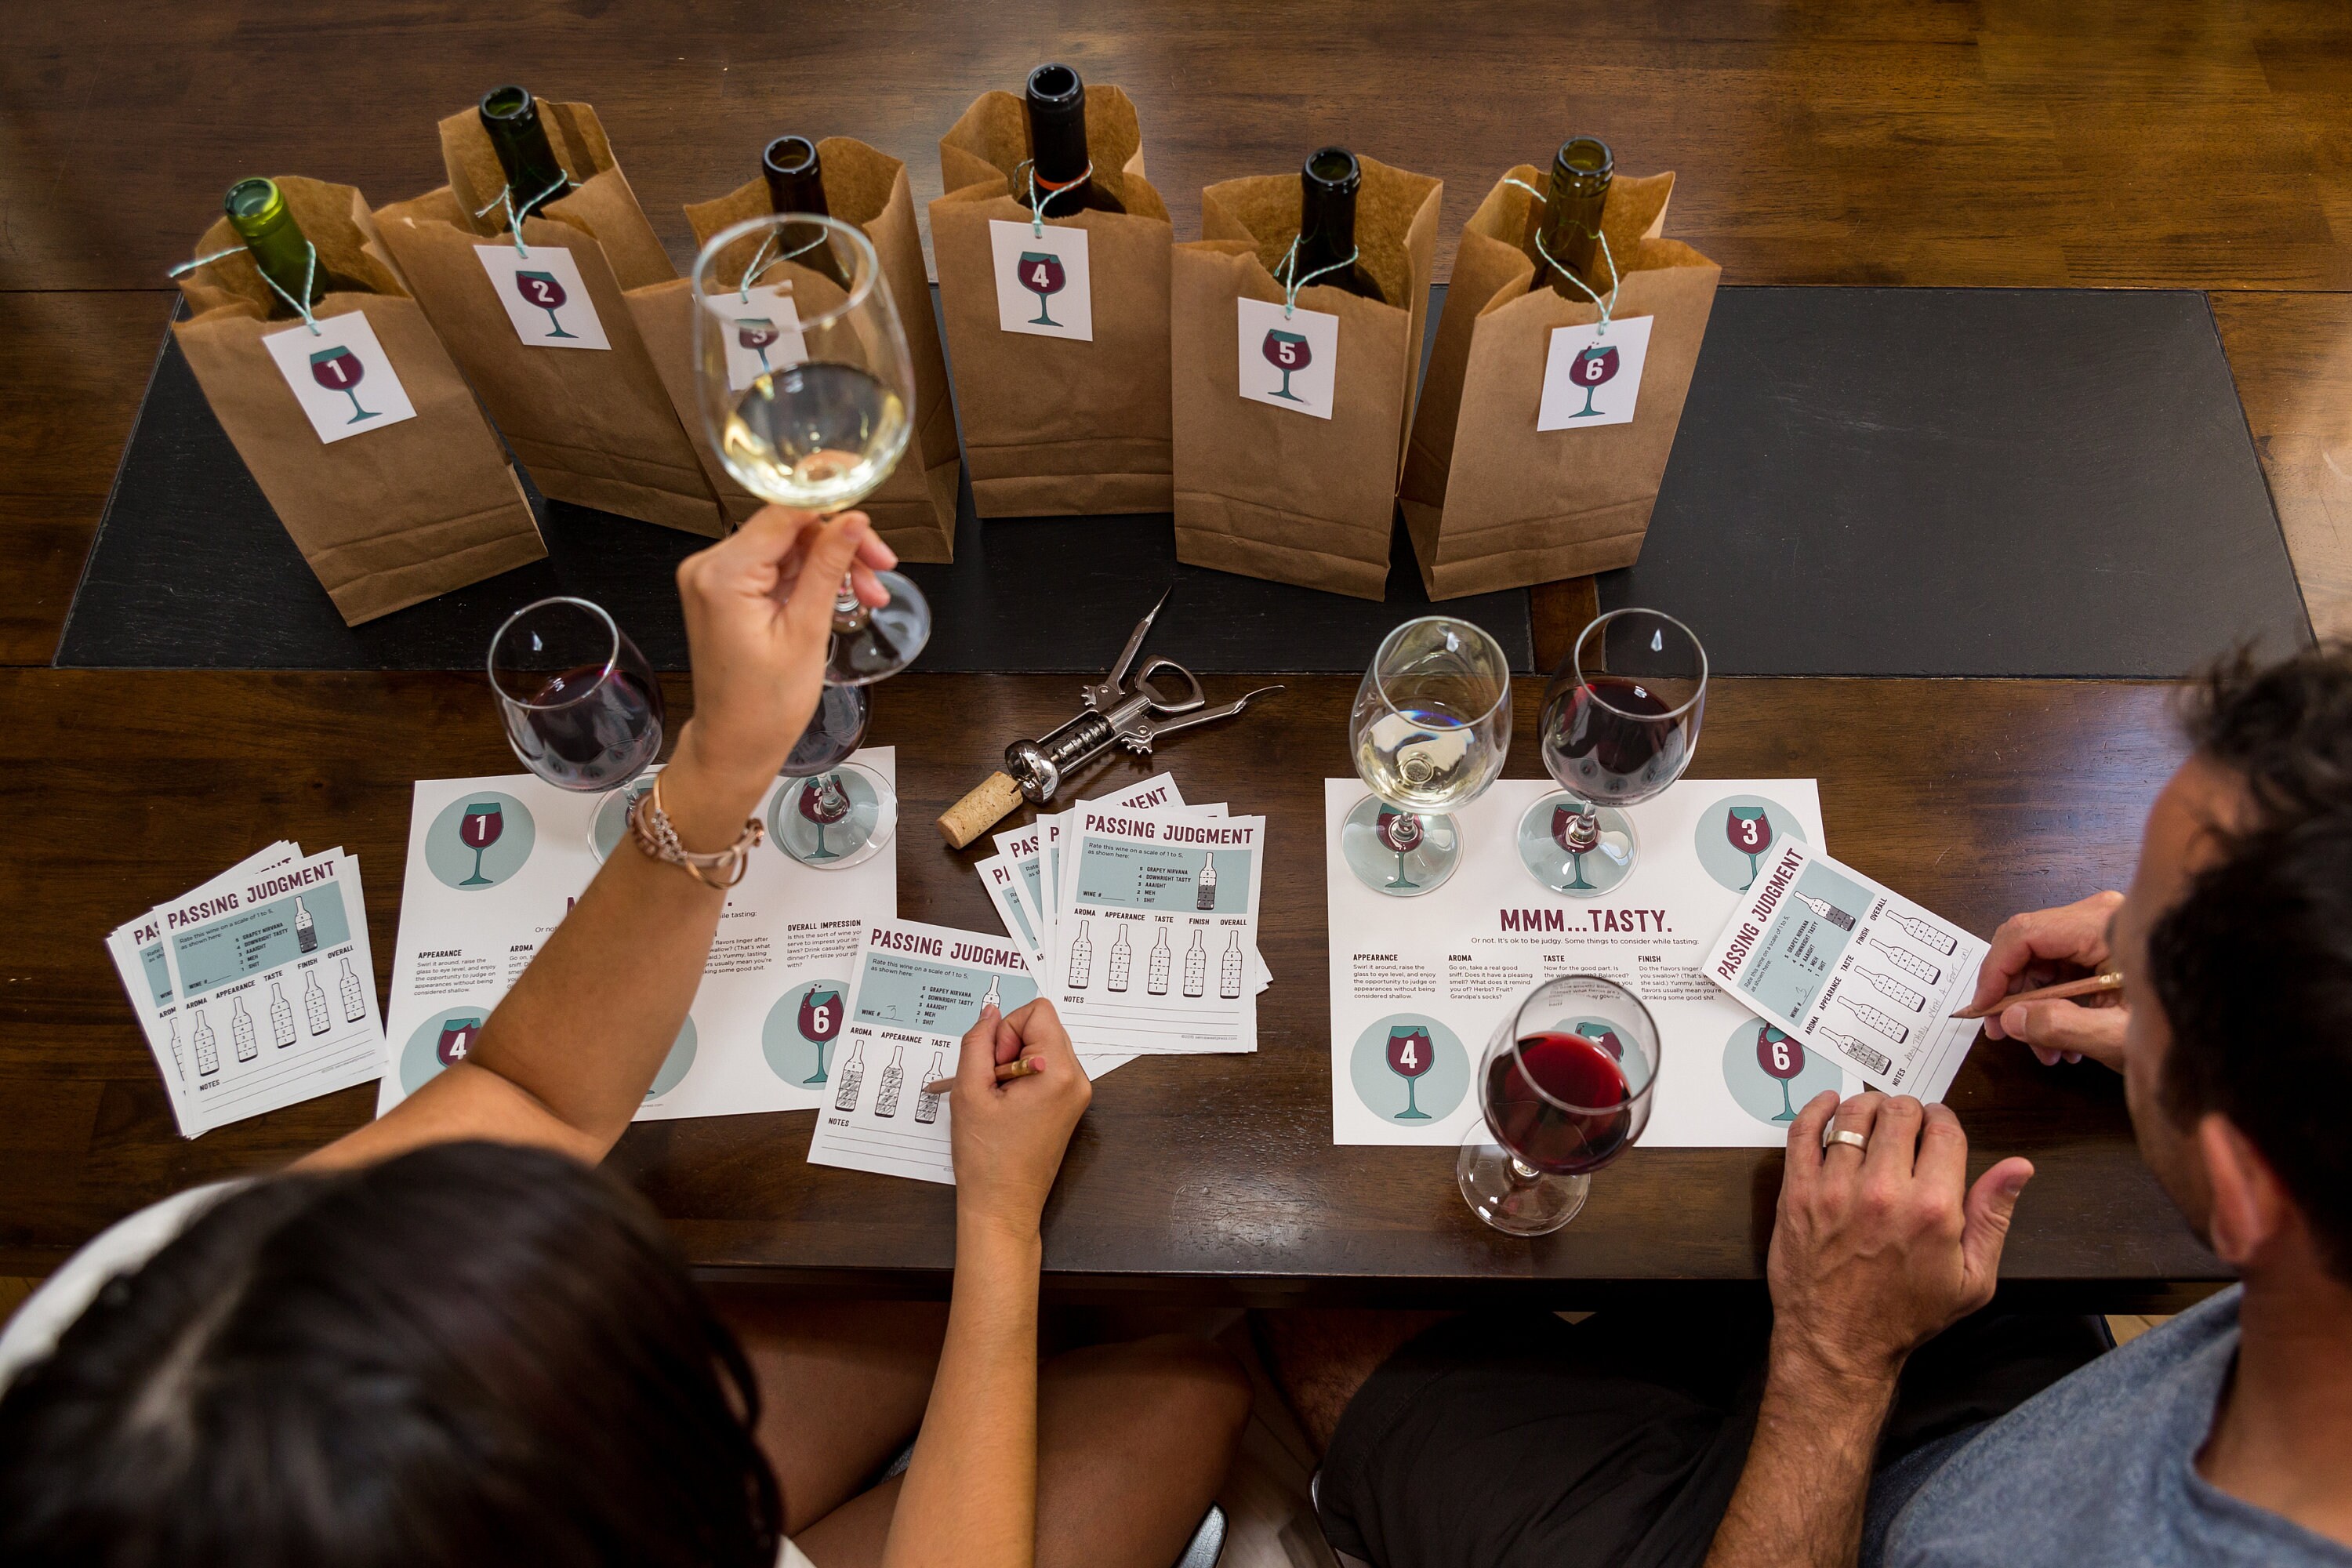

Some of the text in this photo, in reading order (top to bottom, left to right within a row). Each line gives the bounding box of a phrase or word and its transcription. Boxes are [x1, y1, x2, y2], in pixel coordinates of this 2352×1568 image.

[1031, 263, 1049, 287] 4
[532, 281, 555, 302] 2
[752, 329, 768, 344] 3
[1279, 341, 1296, 364] 5
[326, 359, 348, 383] 1
[1585, 357, 1604, 380] 6
[476, 815, 486, 840] 1
[1085, 813, 1155, 839] PASSING
[1163, 824, 1254, 844] JUDGMENT
[1741, 818, 1759, 845] 3
[1095, 849, 1114, 859] shown
[167, 893, 239, 930] PASSING
[247, 860, 334, 903] JUDGMENT
[787, 919, 861, 931] OVERALL IMPRESSION
[1073, 907, 1096, 916] AROMA
[1104, 911, 1145, 921] APPEARANCE
[1154, 915, 1174, 923] TASTE
[1499, 909, 1672, 932] MMM...TASTY.
[1716, 848, 1803, 981] PASSING JUDGMENT
[509, 944, 533, 952] AROMA
[870, 927, 943, 957] PASSING
[417, 949, 462, 959] APPEARANCE
[185, 944, 354, 1010] AROMA APPEARANCE TASTE FINISH OVERALL
[1804, 897, 1887, 1035] AROMA APPEARANCE TASTE FINISH OVERALL
[1063, 995, 1084, 1003] NOTES
[1795, 986, 1807, 998] 3
[813, 1005, 830, 1034] 6
[1789, 1005, 1800, 1018] WINE
[449, 1032, 467, 1060] 4
[849, 1026, 951, 1048] AROMA APPEARANCE TASTE
[1399, 1040, 1418, 1069] 4
[1772, 1041, 1791, 1071] 6
[199, 1079, 220, 1091] NOTES
[1891, 1067, 1906, 1087] NOTES
[827, 1117, 850, 1127] NOTES
